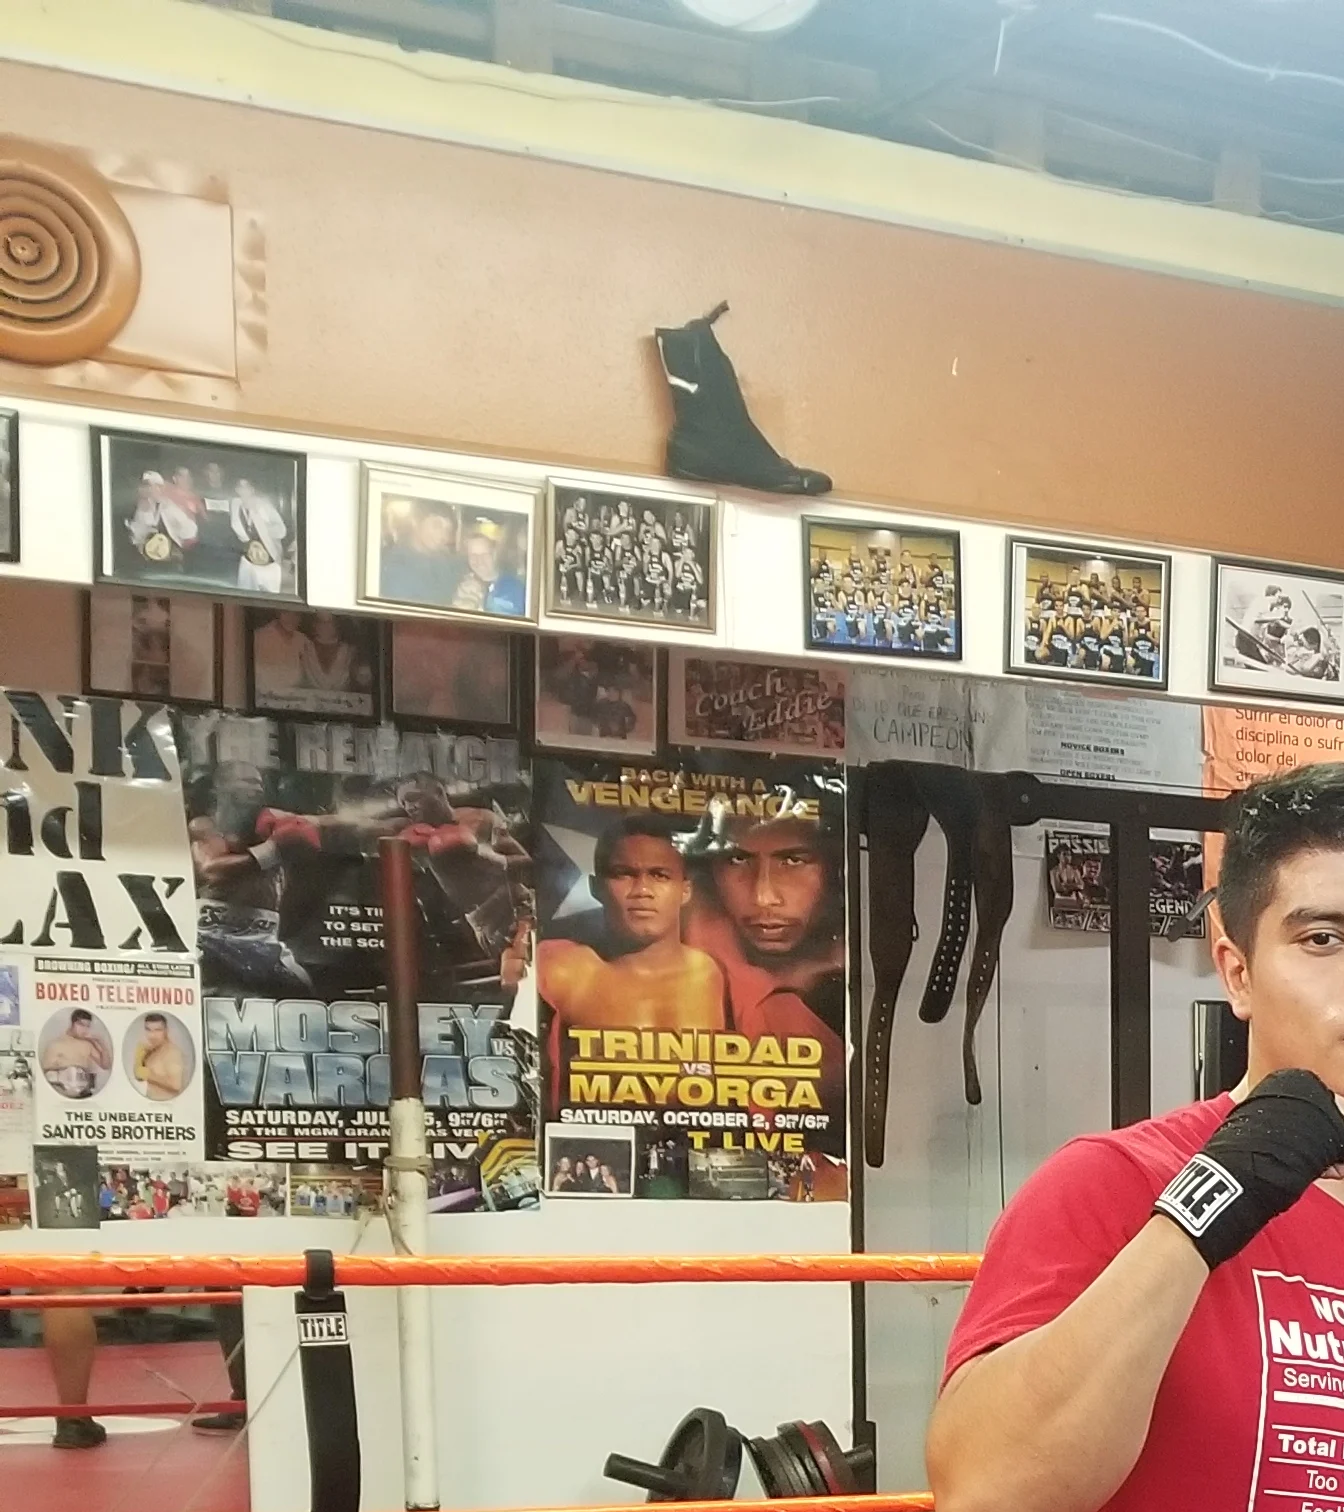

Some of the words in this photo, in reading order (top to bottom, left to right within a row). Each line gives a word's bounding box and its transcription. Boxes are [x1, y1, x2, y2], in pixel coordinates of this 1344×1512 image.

[1235, 727, 1299, 746] disciplina
[1304, 737, 1313, 747] o
[1236, 748, 1272, 764] dolor
[1276, 751, 1297, 766] del
[620, 766, 683, 786] BACK
[691, 772, 746, 790] WITH
[752, 777, 767, 792] A
[564, 778, 821, 821] VENGEANCE
[329, 905, 360, 916] IT'S
[324, 920, 346, 931] TO
[320, 936, 352, 947] THE
[35, 981, 91, 1002] BOXEO
[96, 984, 195, 1006] TELEMUNDO
[203, 997, 504, 1058] MOSEY
[491, 1038, 515, 1056] VS
[568, 1029, 823, 1066] TRINIDAD
[683, 1062, 714, 1076] VS
[569, 1073, 823, 1109] MAYORGA
[65, 1111, 93, 1122] THE
[98, 1112, 173, 1123] UNBEATEN
[225, 1110, 344, 1129] SATURDAY,
[560, 1108, 659, 1126] SATURDAY,
[663, 1111, 749, 1127] OCTOBER
[752, 1114, 770, 1130] 2,
[42, 1124, 106, 1139] SANTOS
[111, 1125, 196, 1140] BROTHERS
[227, 1127, 250, 1136] AT
[257, 1127, 288, 1136] THE
[294, 1128, 339, 1137] MGM
[724, 1132, 805, 1152] LIVE
[228, 1141, 328, 1159] SEE
[300, 1317, 344, 1338] TITLE
[1277, 1432, 1337, 1460] Total
[1306, 1469, 1338, 1492] Too
